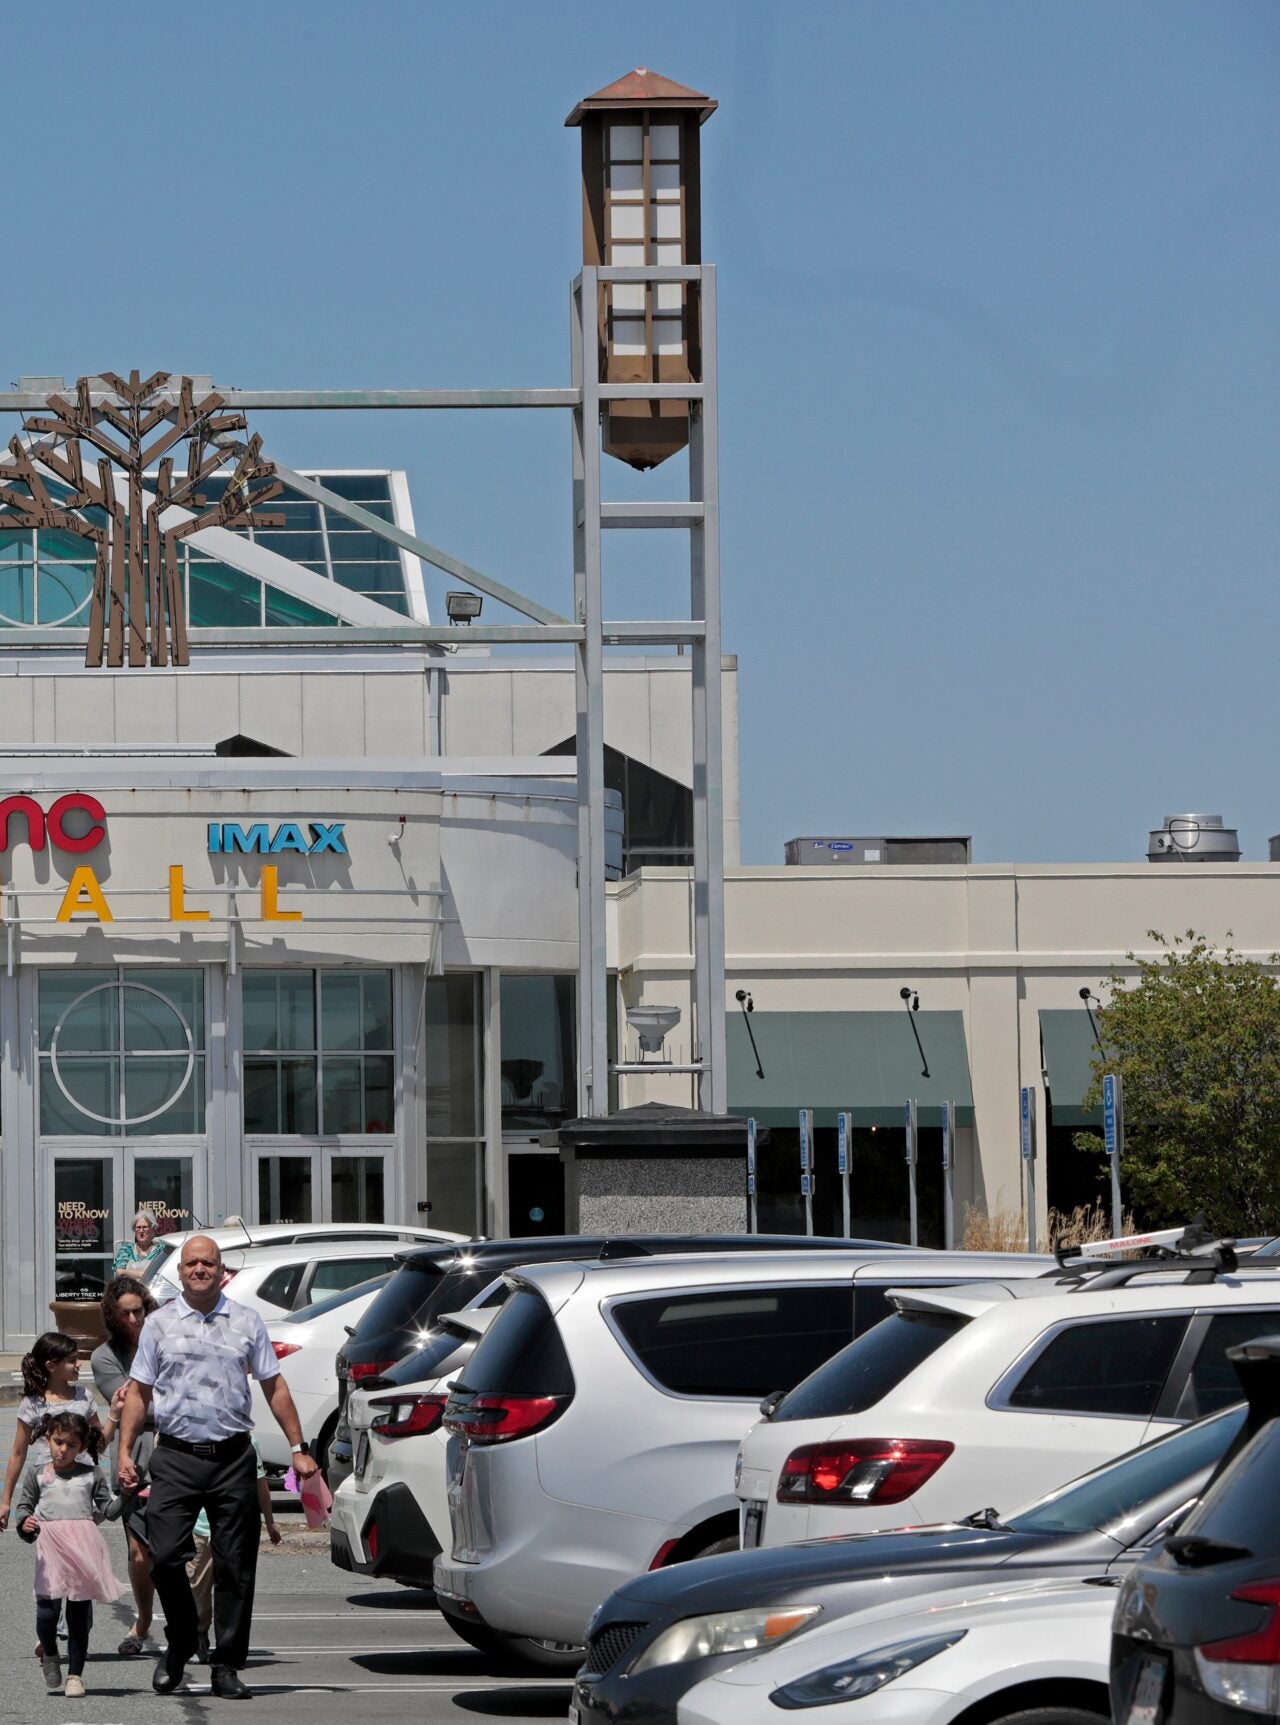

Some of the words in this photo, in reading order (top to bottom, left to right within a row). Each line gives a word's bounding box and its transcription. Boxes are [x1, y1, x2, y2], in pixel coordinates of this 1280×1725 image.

[207, 823, 347, 854] IMAX
[58, 1202, 86, 1211] NEED
[138, 1200, 166, 1210] NEED
[58, 1209, 73, 1219] TO
[74, 1209, 109, 1219] KNOW
[155, 1208, 189, 1218] KNOW
[1109, 1236, 1153, 1249] MALONE
